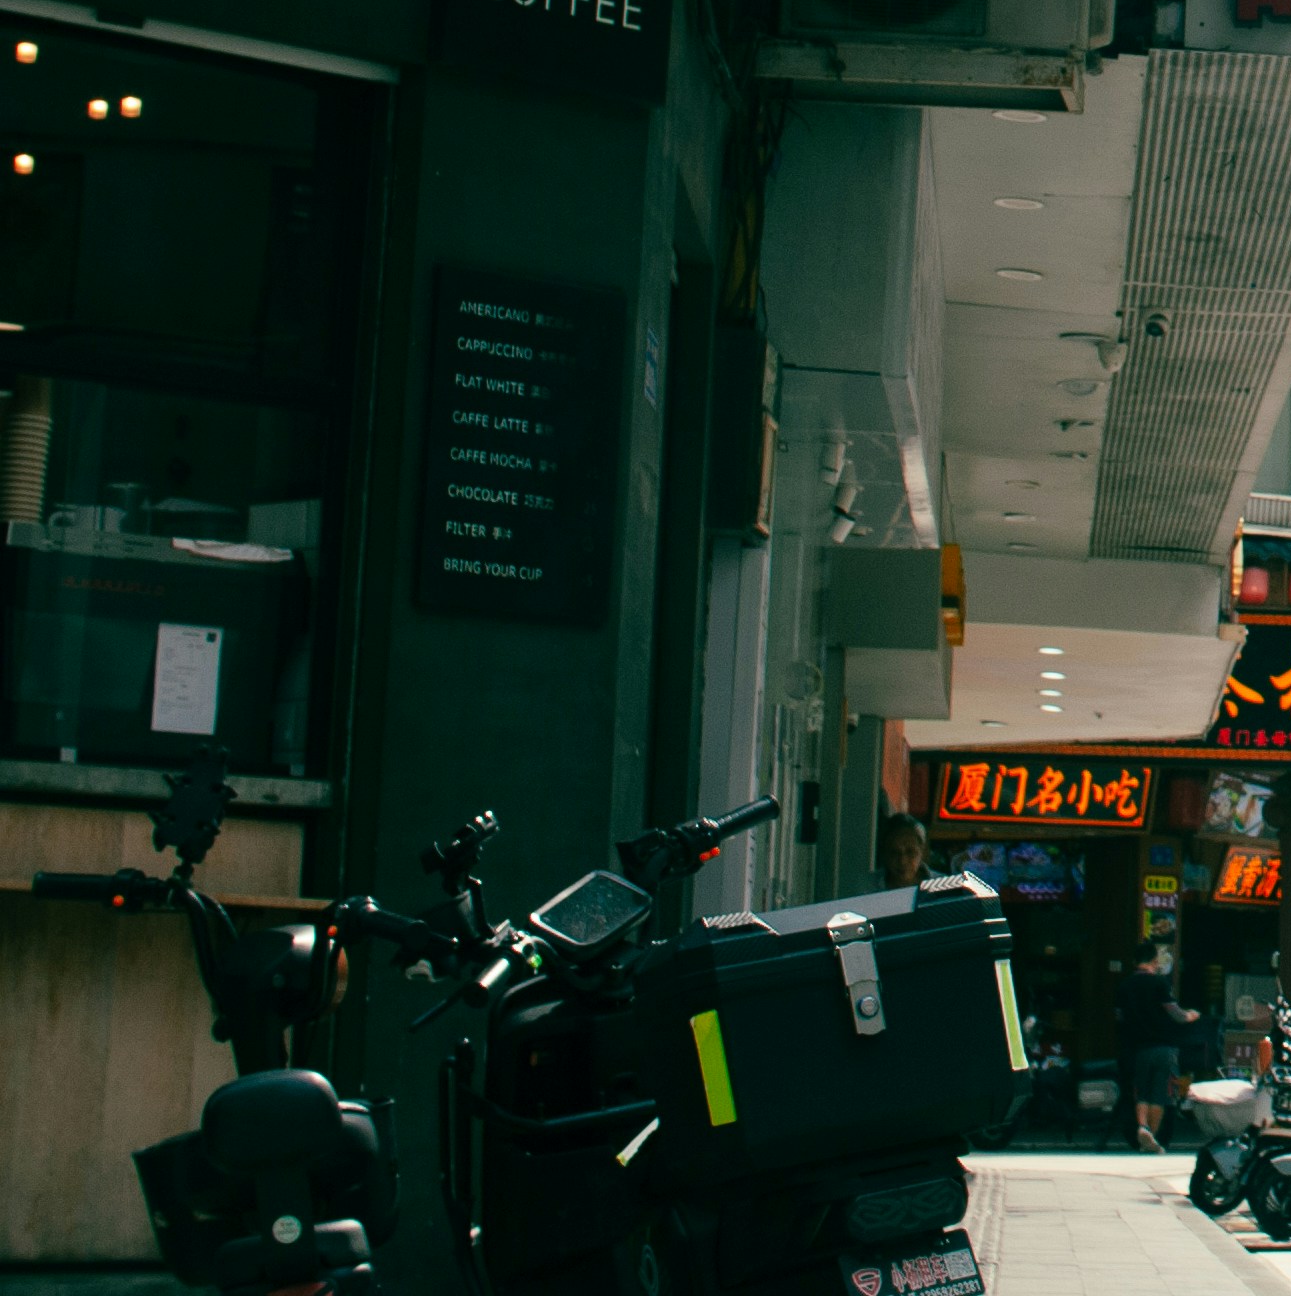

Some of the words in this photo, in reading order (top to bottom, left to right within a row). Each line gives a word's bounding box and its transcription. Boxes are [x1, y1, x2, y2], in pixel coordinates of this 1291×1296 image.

[459, 300, 530, 324] AMERICANO
[456, 336, 534, 361] CAPPUCCINO
[455, 372, 483, 390] FLAT
[486, 378, 526, 397] WHITE
[452, 410, 490, 428] CAFFE
[494, 415, 529, 434] LATTE
[450, 446, 487, 466] CAFFE
[489, 452, 533, 471] MOCHA
[447, 483, 519, 506] CHOCOLATE
[445, 520, 488, 538] FILTER
[443, 557, 483, 575] BRING
[485, 563, 518, 578] YOUR
[519, 566, 544, 580] CUP
[949, 762, 1139, 819] 厦门名小吃
